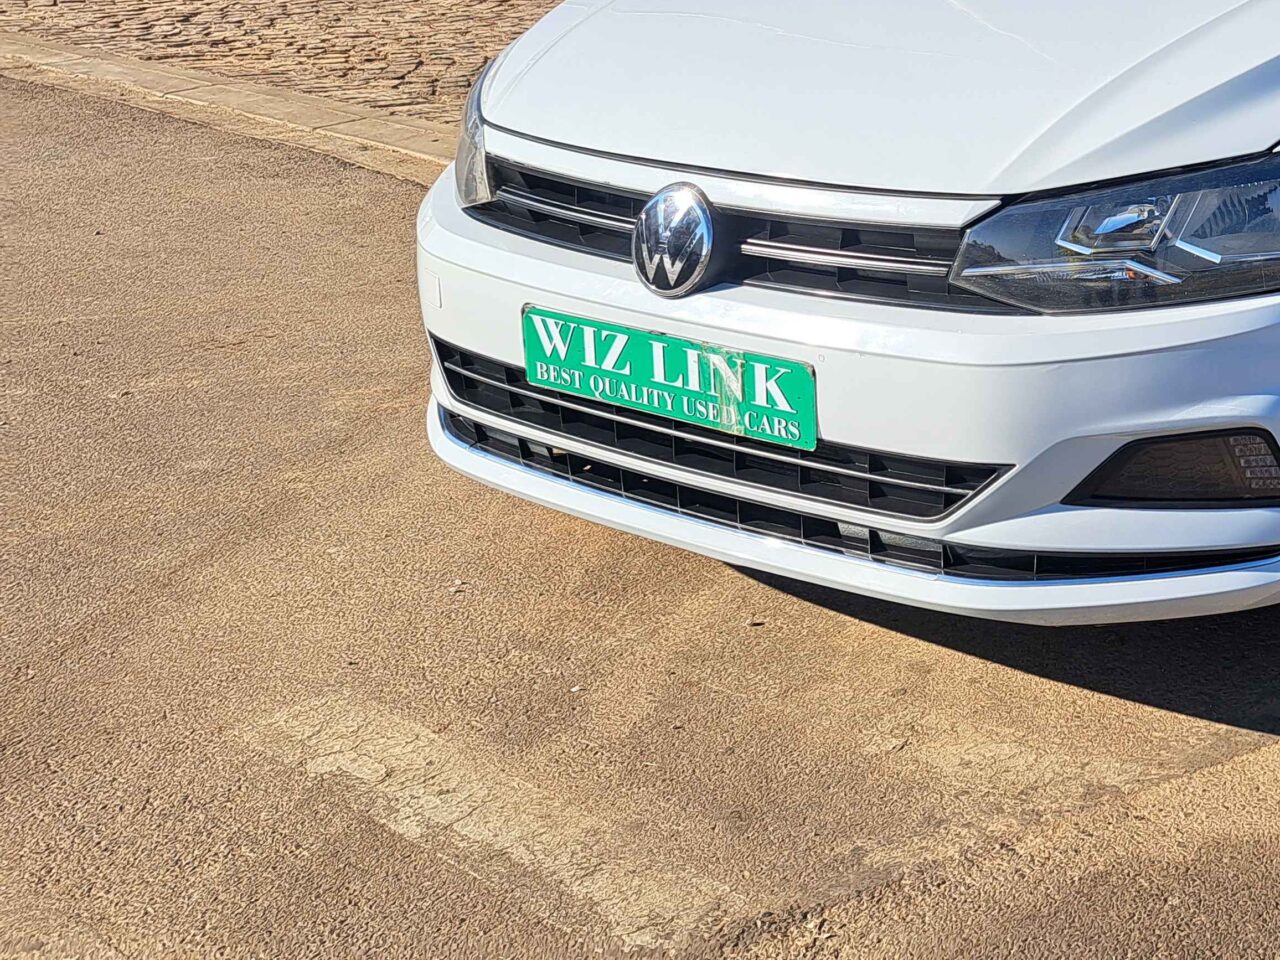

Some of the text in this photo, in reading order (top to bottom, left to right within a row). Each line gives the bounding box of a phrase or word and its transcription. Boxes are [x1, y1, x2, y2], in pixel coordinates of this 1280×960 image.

[528, 313, 797, 414] WIZ LINK
[535, 361, 801, 441] BEST QUALITY USED CARS
